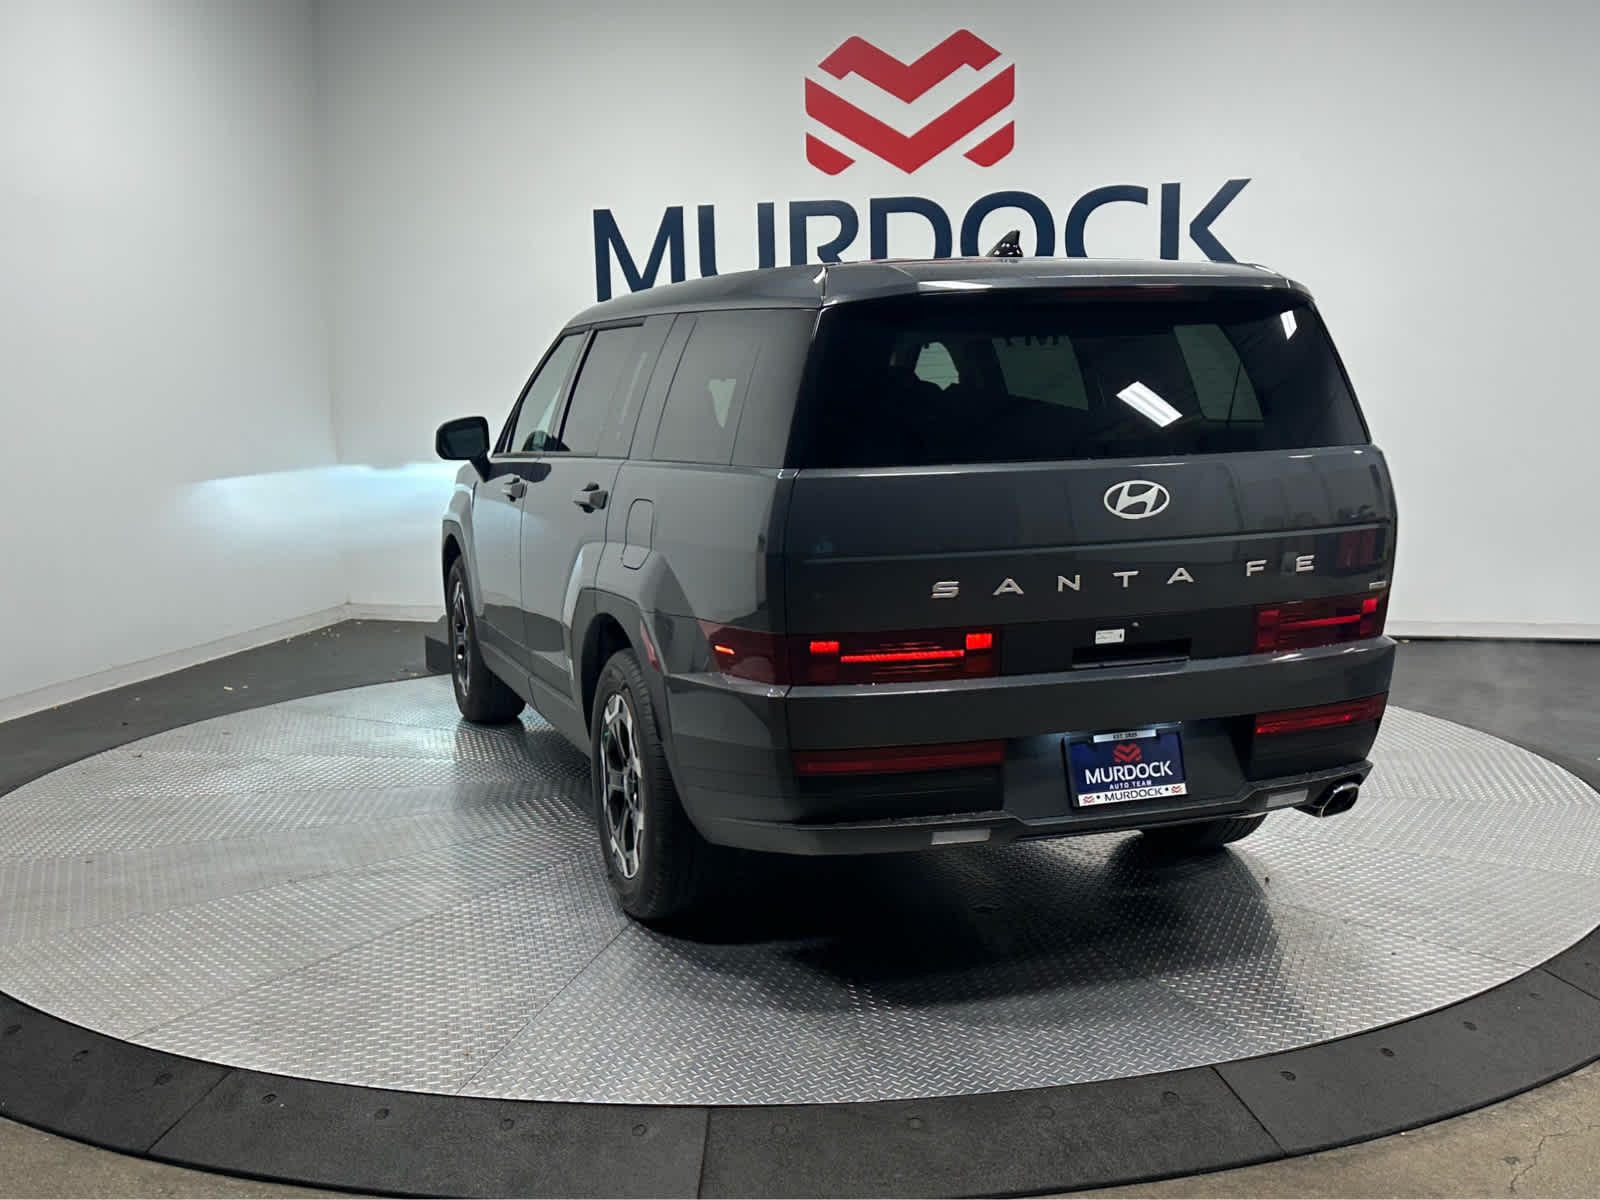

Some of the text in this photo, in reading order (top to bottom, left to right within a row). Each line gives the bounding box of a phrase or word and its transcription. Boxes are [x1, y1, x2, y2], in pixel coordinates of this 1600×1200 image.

[593, 178, 1252, 302] MURDOCK
[931, 554, 1315, 598] SANTA FE
[1085, 760, 1173, 785] MURDOCK
[1132, 780, 1152, 788] TEAM
[1104, 787, 1162, 802] MURDOCK
